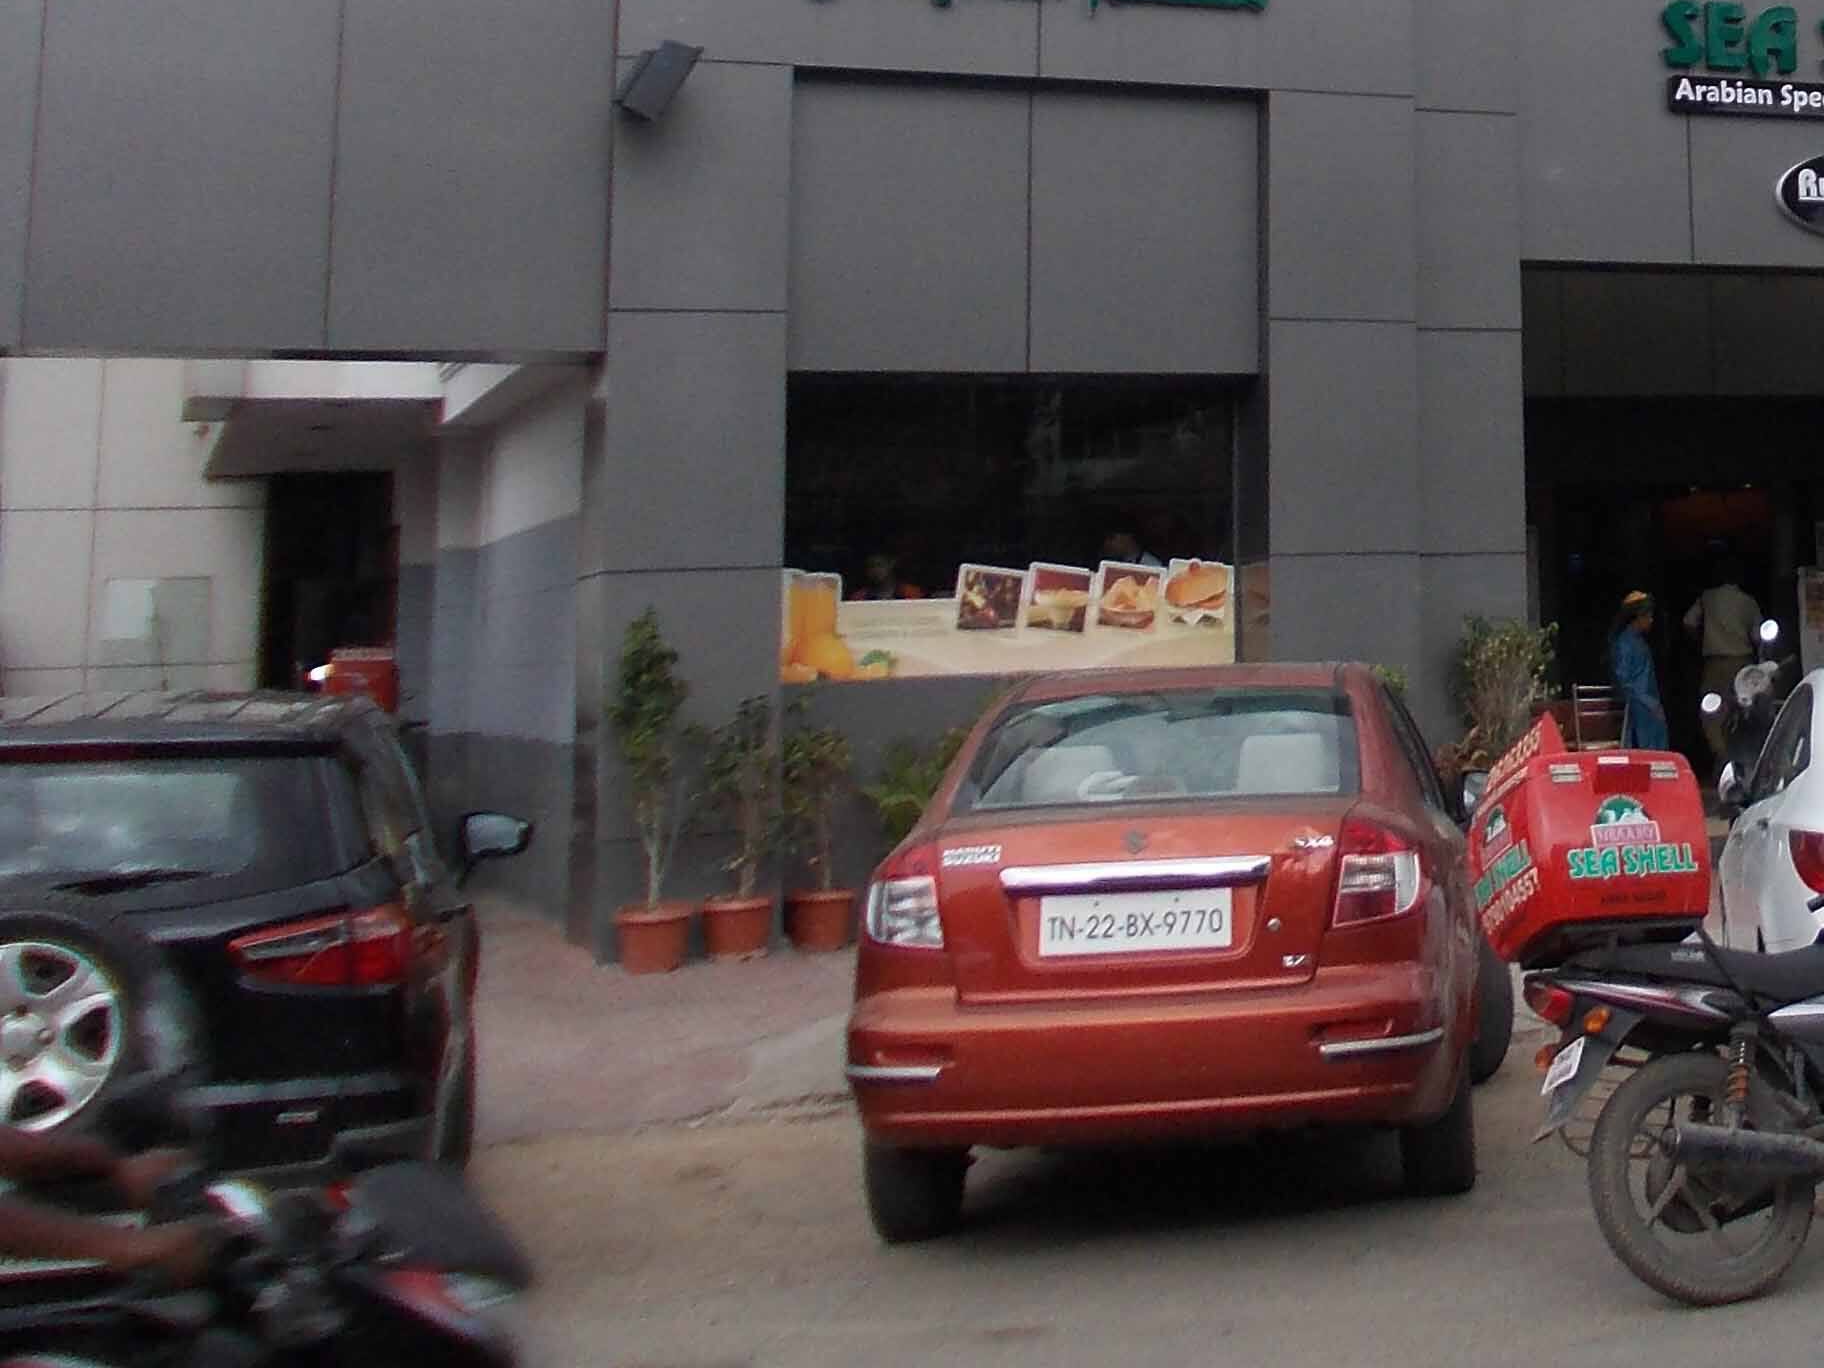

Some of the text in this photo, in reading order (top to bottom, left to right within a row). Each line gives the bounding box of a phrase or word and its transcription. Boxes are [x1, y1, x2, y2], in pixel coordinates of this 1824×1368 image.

[1675, 78, 1774, 107] Arabian
[1568, 842, 1699, 880] SEA SHELL
[1047, 908, 1224, 940] TN-22-BX-9770
